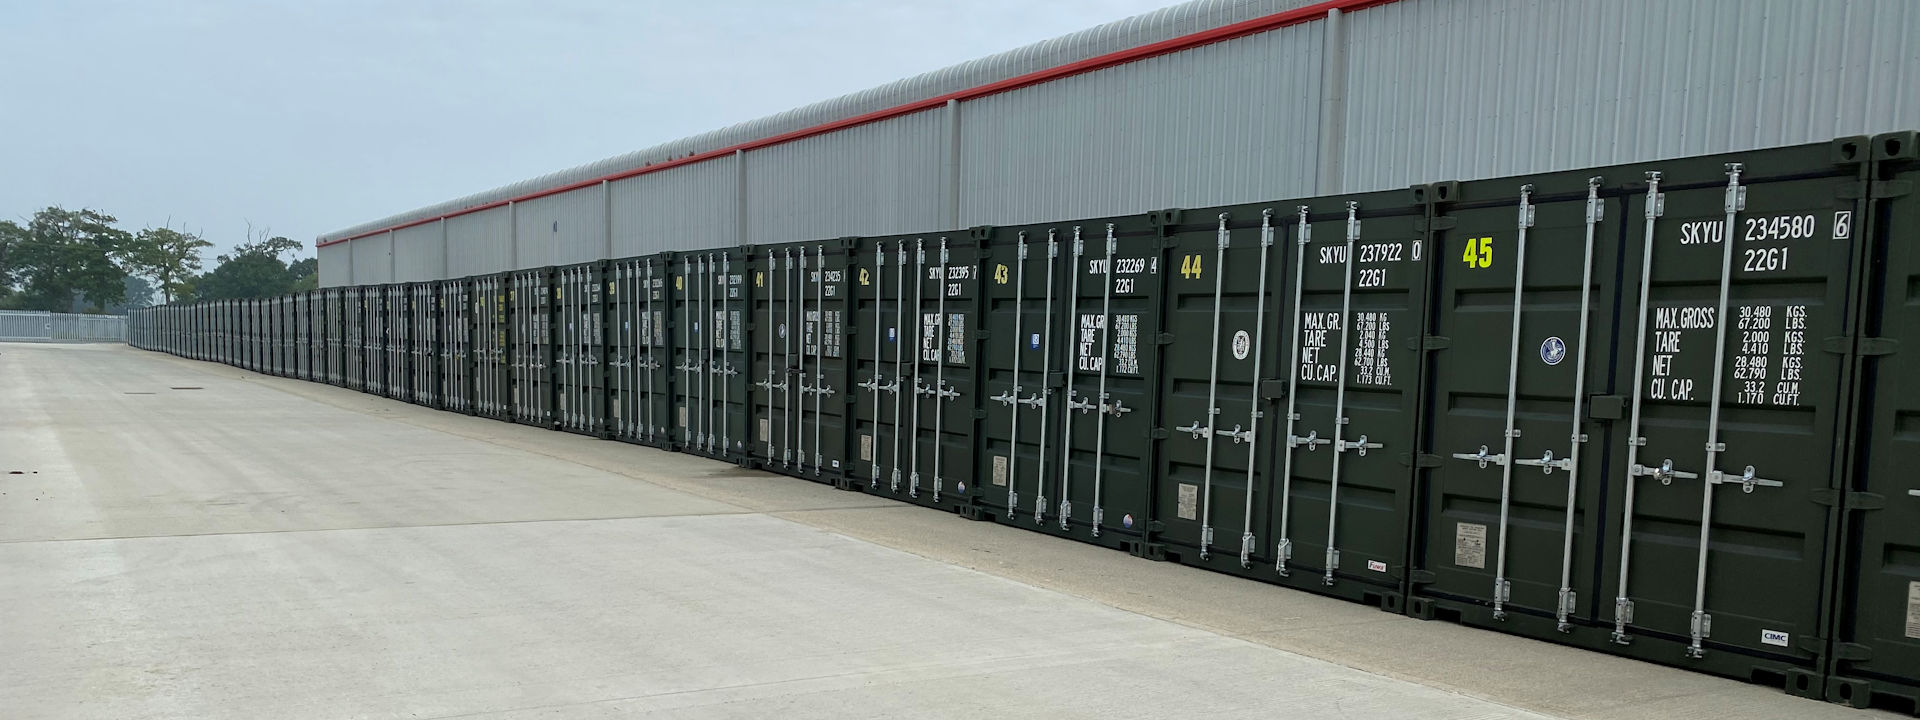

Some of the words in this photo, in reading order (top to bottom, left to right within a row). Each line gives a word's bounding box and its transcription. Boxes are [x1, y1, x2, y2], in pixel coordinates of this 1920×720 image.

[1680, 220, 1723, 244] SKYU
[1744, 214, 1815, 241] 234580
[1834, 212, 1850, 238] 6
[1319, 245, 1347, 264] SKYU
[1359, 242, 1403, 263] 237922
[1462, 236, 1493, 269] 45
[1743, 247, 1788, 272] 22G1
[994, 263, 1009, 285] 43
[1115, 258, 1145, 274] 232269
[1180, 254, 1202, 279] 44
[859, 268, 870, 286] 42
[1115, 278, 1134, 294] 22G1
[1358, 268, 1386, 287] 22G1
[1080, 328, 1096, 343] TARE
[1303, 329, 1328, 348] TARE
[1655, 331, 1682, 353] TARE
[1079, 342, 1092, 357] NET
[1301, 346, 1321, 364] NET
[1652, 354, 1673, 376] NET
[1743, 380, 1766, 393] 33.2
[1764, 632, 1786, 642] CIMC
